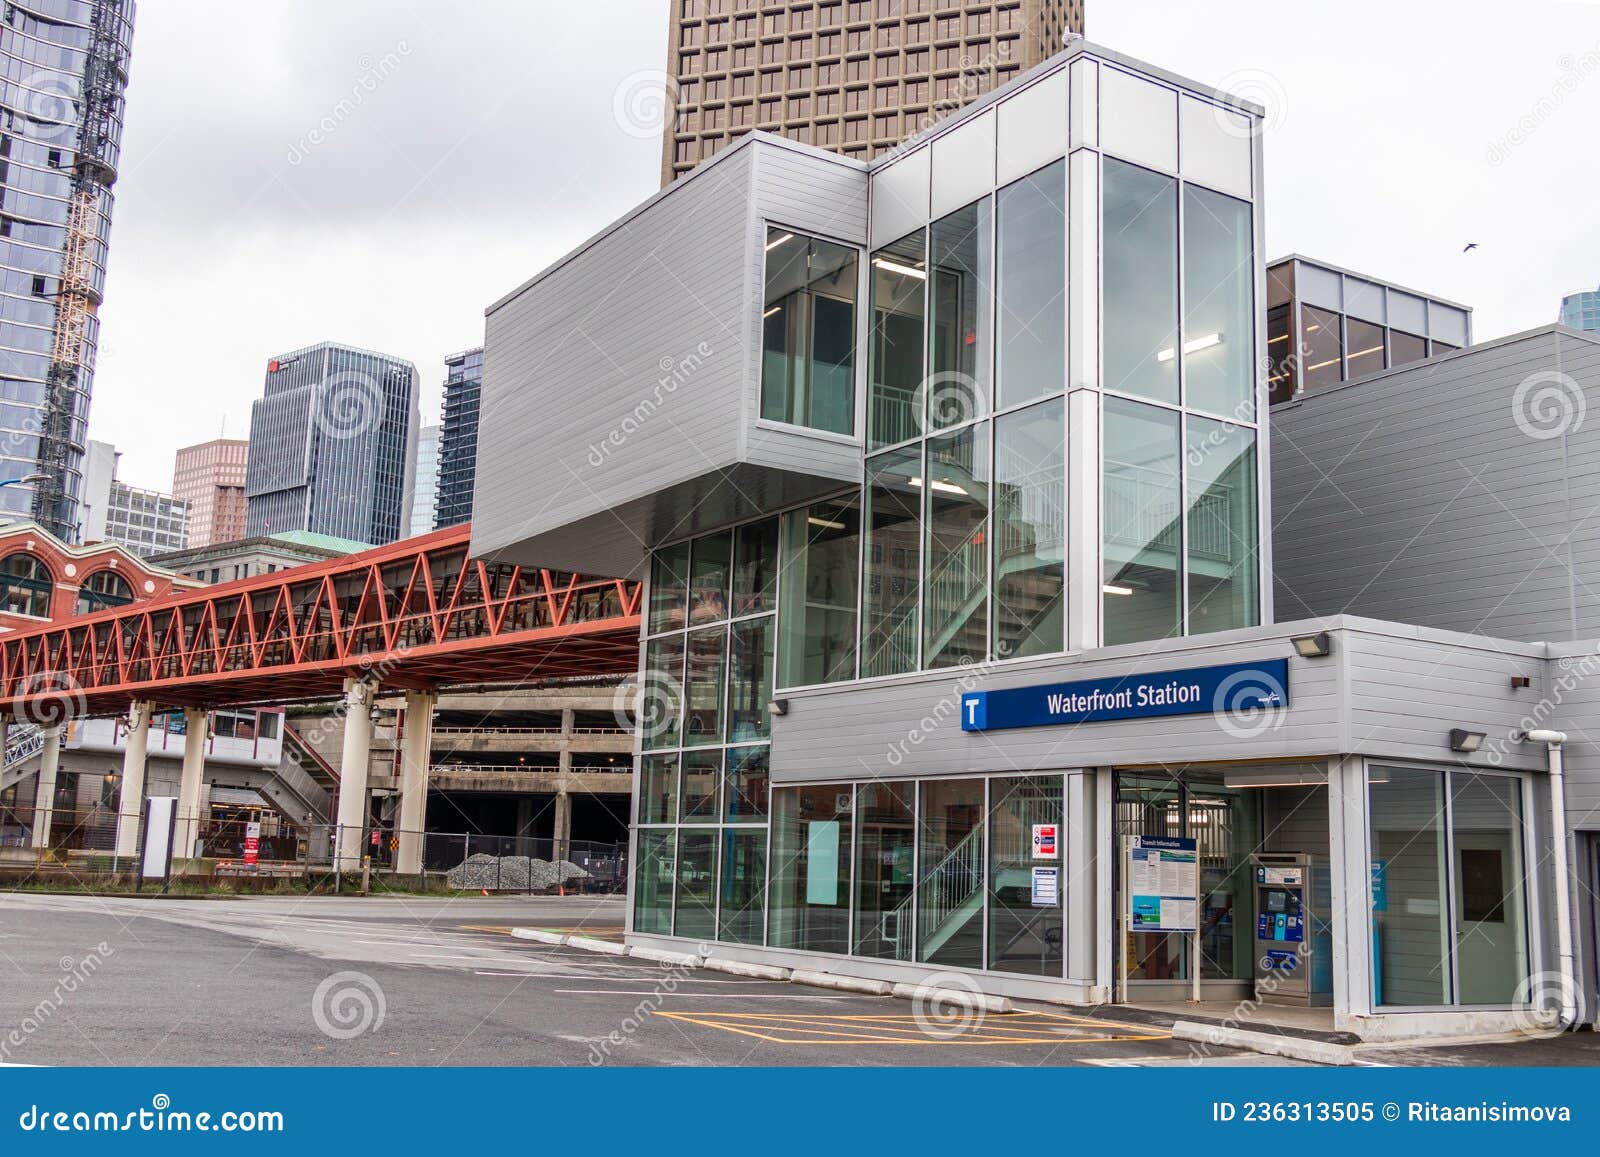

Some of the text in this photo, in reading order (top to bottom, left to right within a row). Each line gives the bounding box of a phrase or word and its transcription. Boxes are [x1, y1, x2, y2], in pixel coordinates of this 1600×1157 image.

[965, 698, 980, 725] T
[1047, 682, 1200, 715] Waterfront Station
